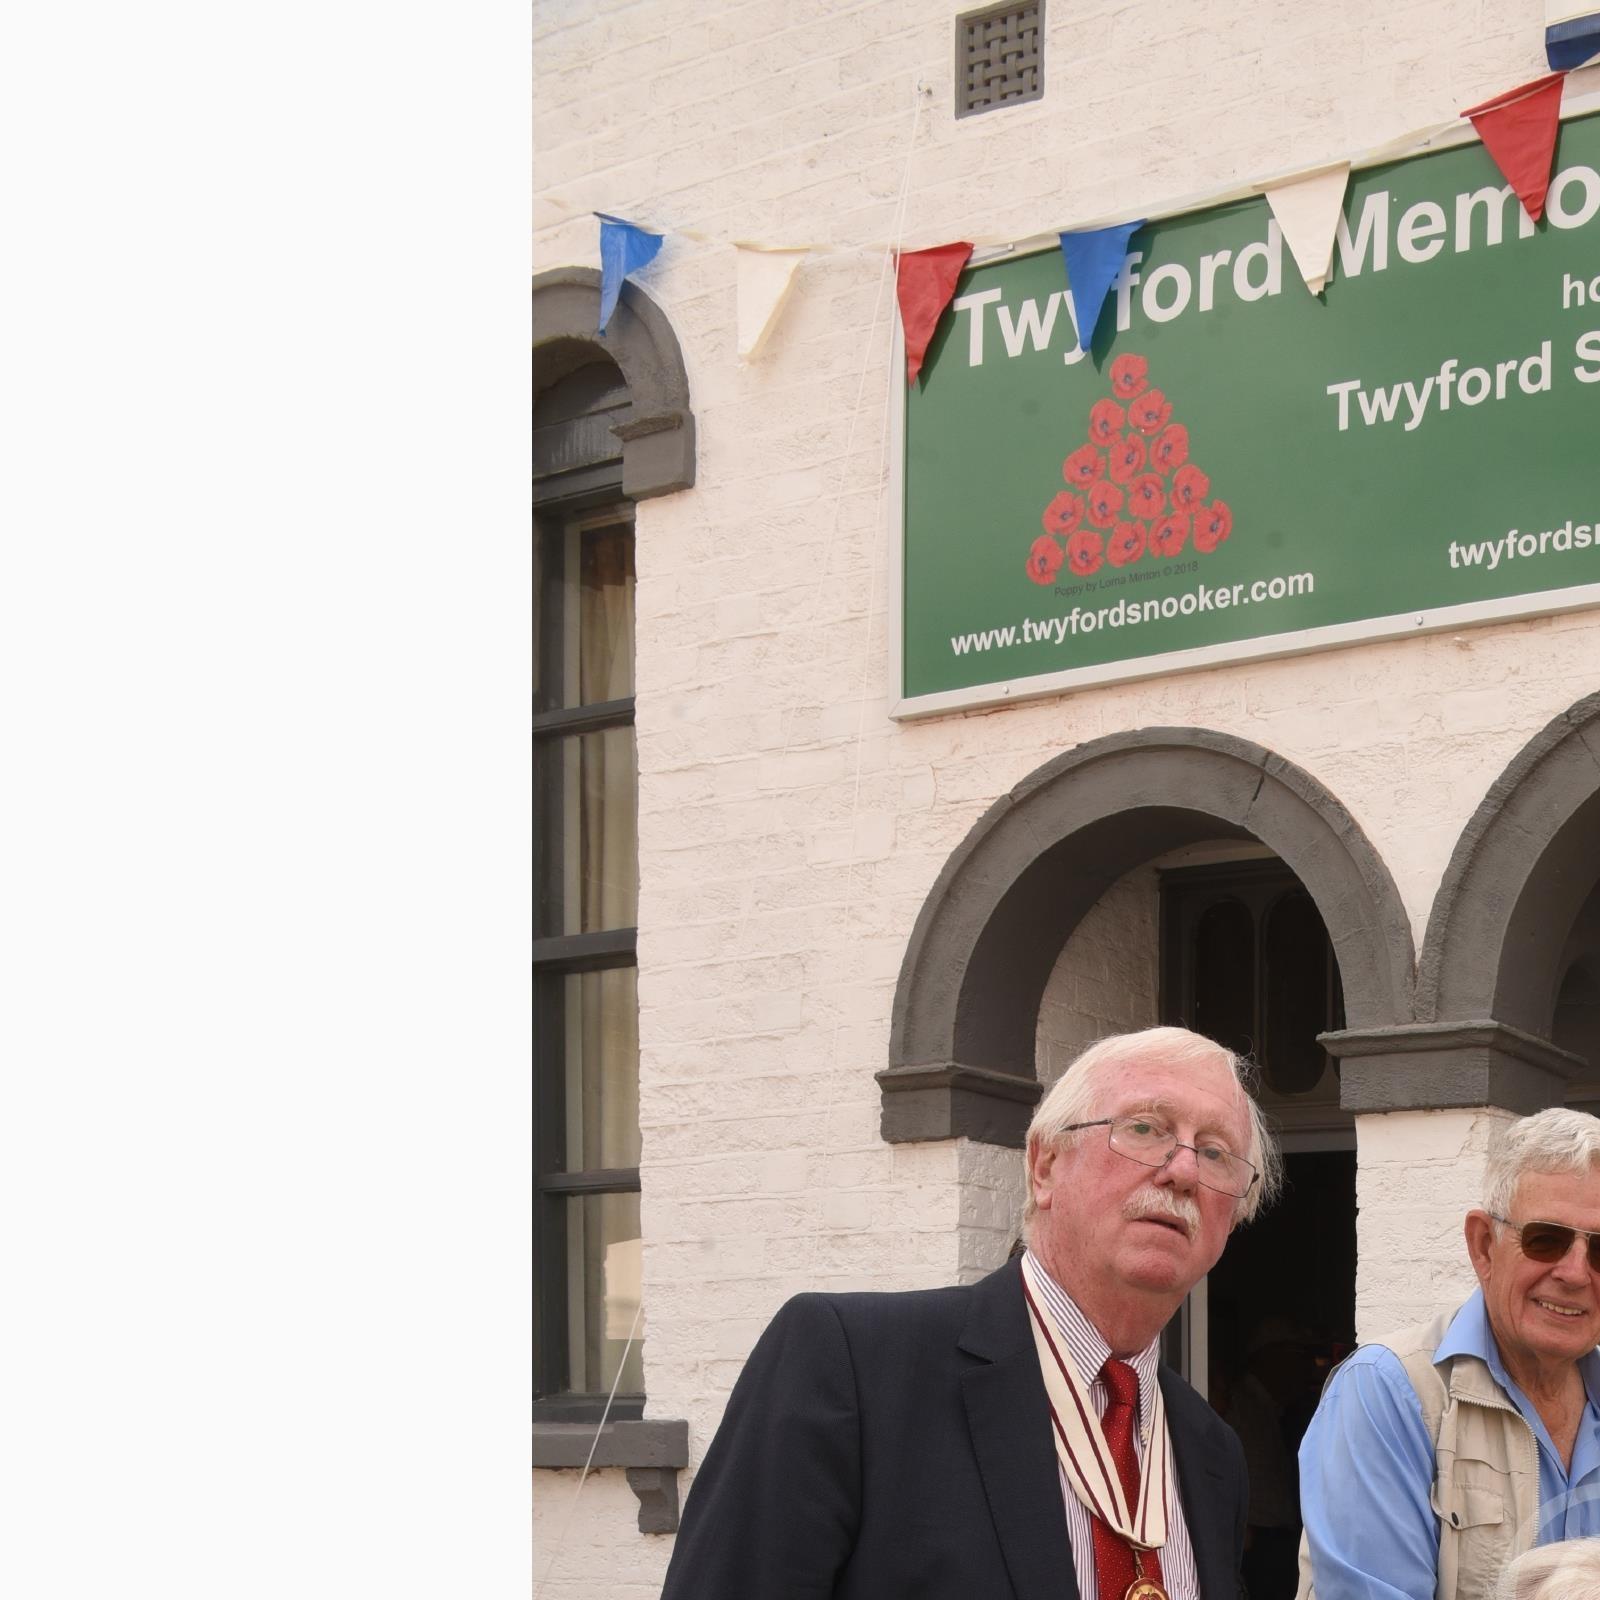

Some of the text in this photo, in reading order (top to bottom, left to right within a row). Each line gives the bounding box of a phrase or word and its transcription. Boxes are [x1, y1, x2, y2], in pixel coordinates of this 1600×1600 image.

[1327, 344, 1552, 432] Twyford
[951, 573, 1314, 656] www.twyfordsnooker.com
[1054, 585, 1083, 598] Poppy
[1086, 582, 1096, 592] by
[1100, 576, 1127, 589] Lorna
[1129, 570, 1160, 584] Minton
[1174, 561, 1200, 574] 2018
